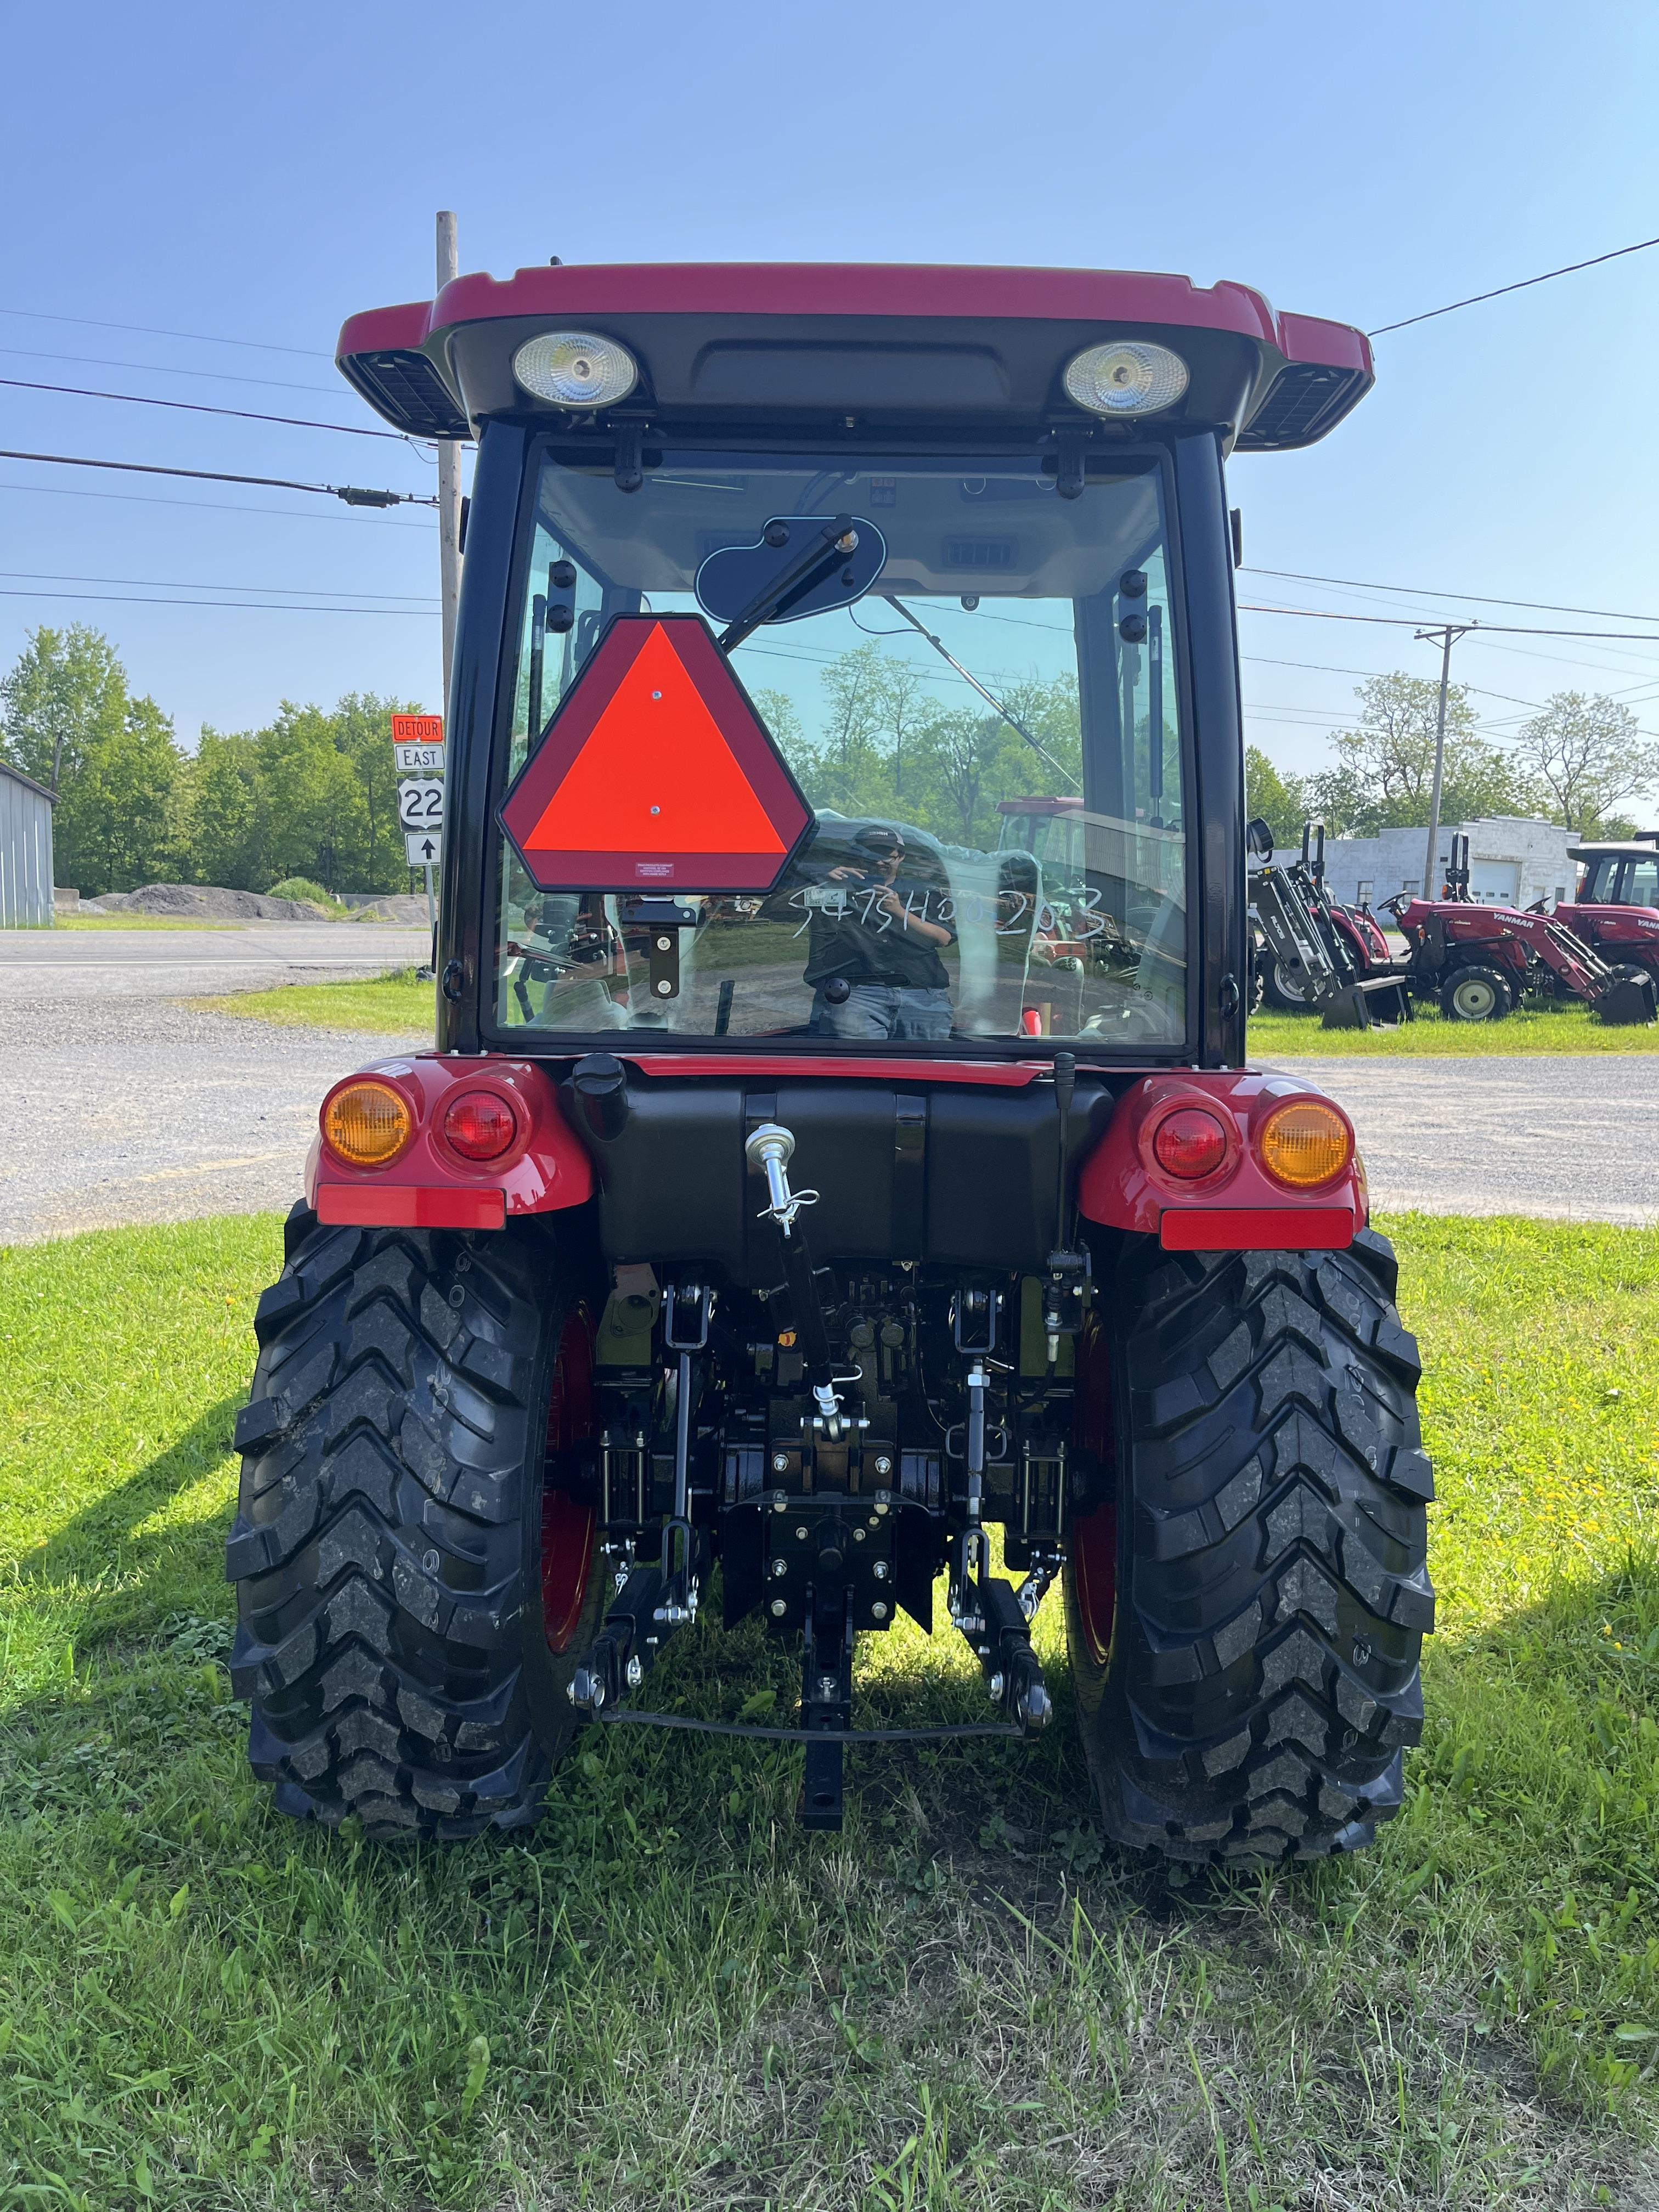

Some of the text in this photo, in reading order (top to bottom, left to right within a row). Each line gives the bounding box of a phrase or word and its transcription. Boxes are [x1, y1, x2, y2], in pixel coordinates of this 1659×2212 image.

[398, 721, 438, 736] DETOUR
[403, 749, 436, 766] EAST
[405, 788, 443, 817] 22
[1493, 912, 1535, 929] YANMAR
